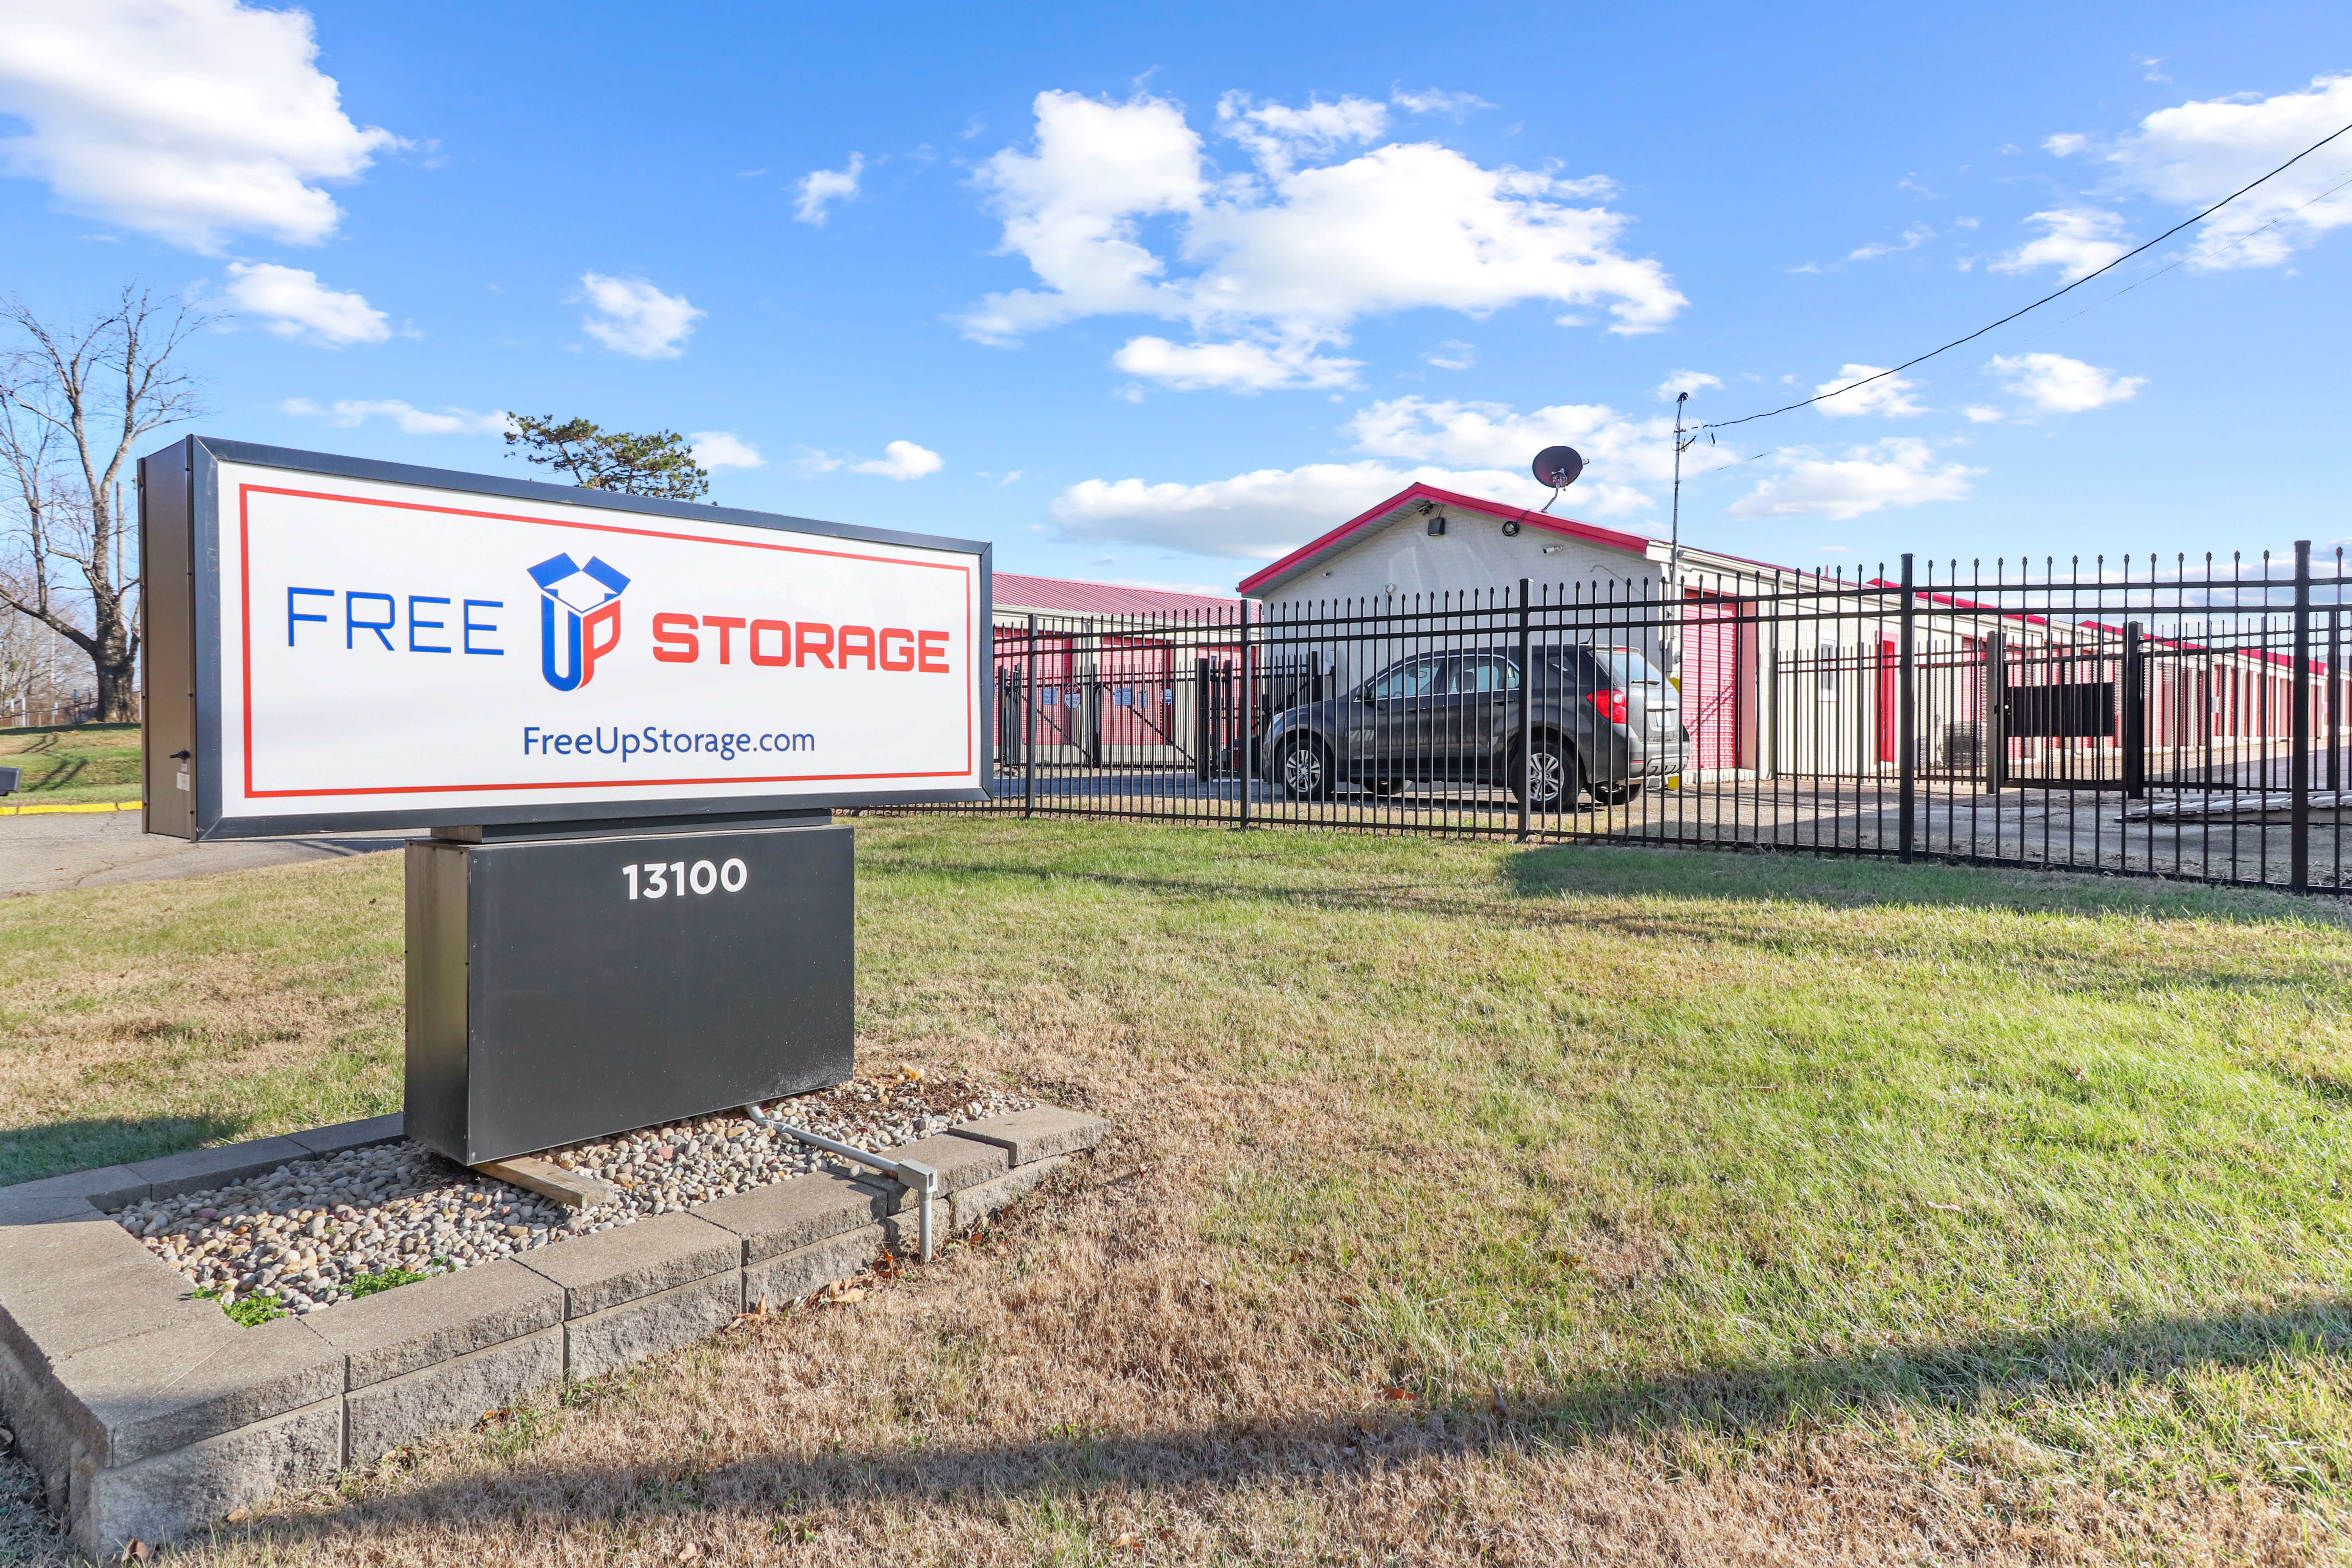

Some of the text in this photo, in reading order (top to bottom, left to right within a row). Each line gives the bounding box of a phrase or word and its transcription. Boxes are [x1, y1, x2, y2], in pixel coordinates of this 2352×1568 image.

[288, 587, 949, 691] FREE UP STORAGE
[524, 727, 814, 762] FreeUpStorage.com
[622, 858, 748, 899] 13100
